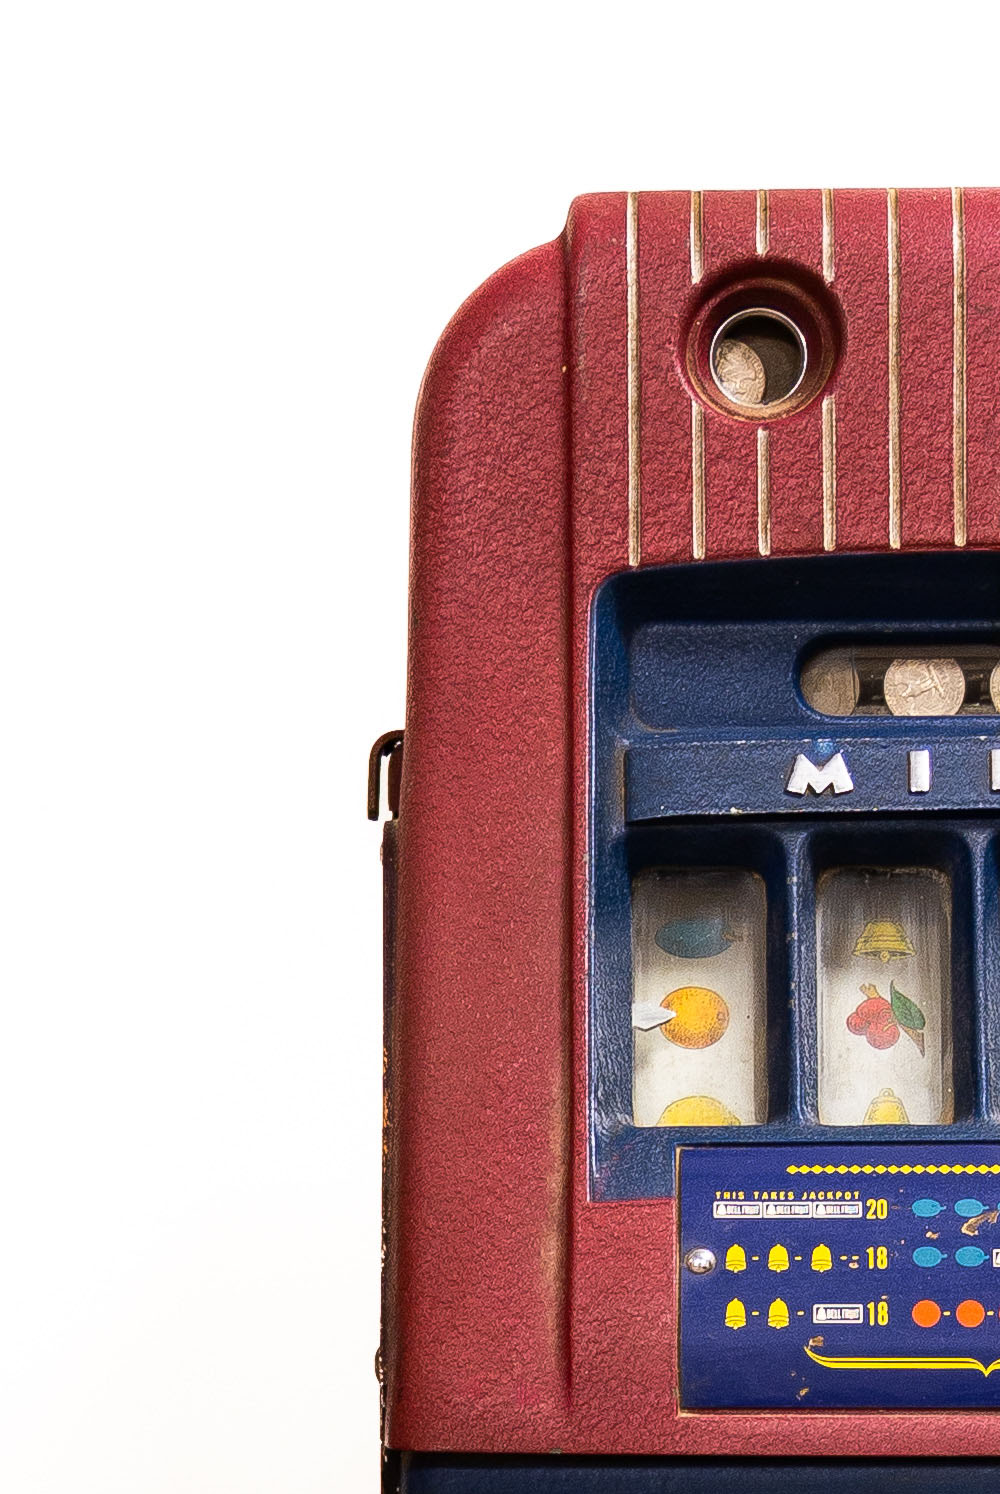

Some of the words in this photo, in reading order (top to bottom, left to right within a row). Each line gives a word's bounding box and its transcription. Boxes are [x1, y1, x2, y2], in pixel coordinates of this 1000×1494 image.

[716, 1191, 745, 1200] THIS
[753, 1191, 795, 1200] TAKES
[801, 1191, 860, 1200] JACKPOT
[865, 1198, 888, 1220] 20
[866, 1246, 888, 1270] 18
[867, 1301, 889, 1326] 18
